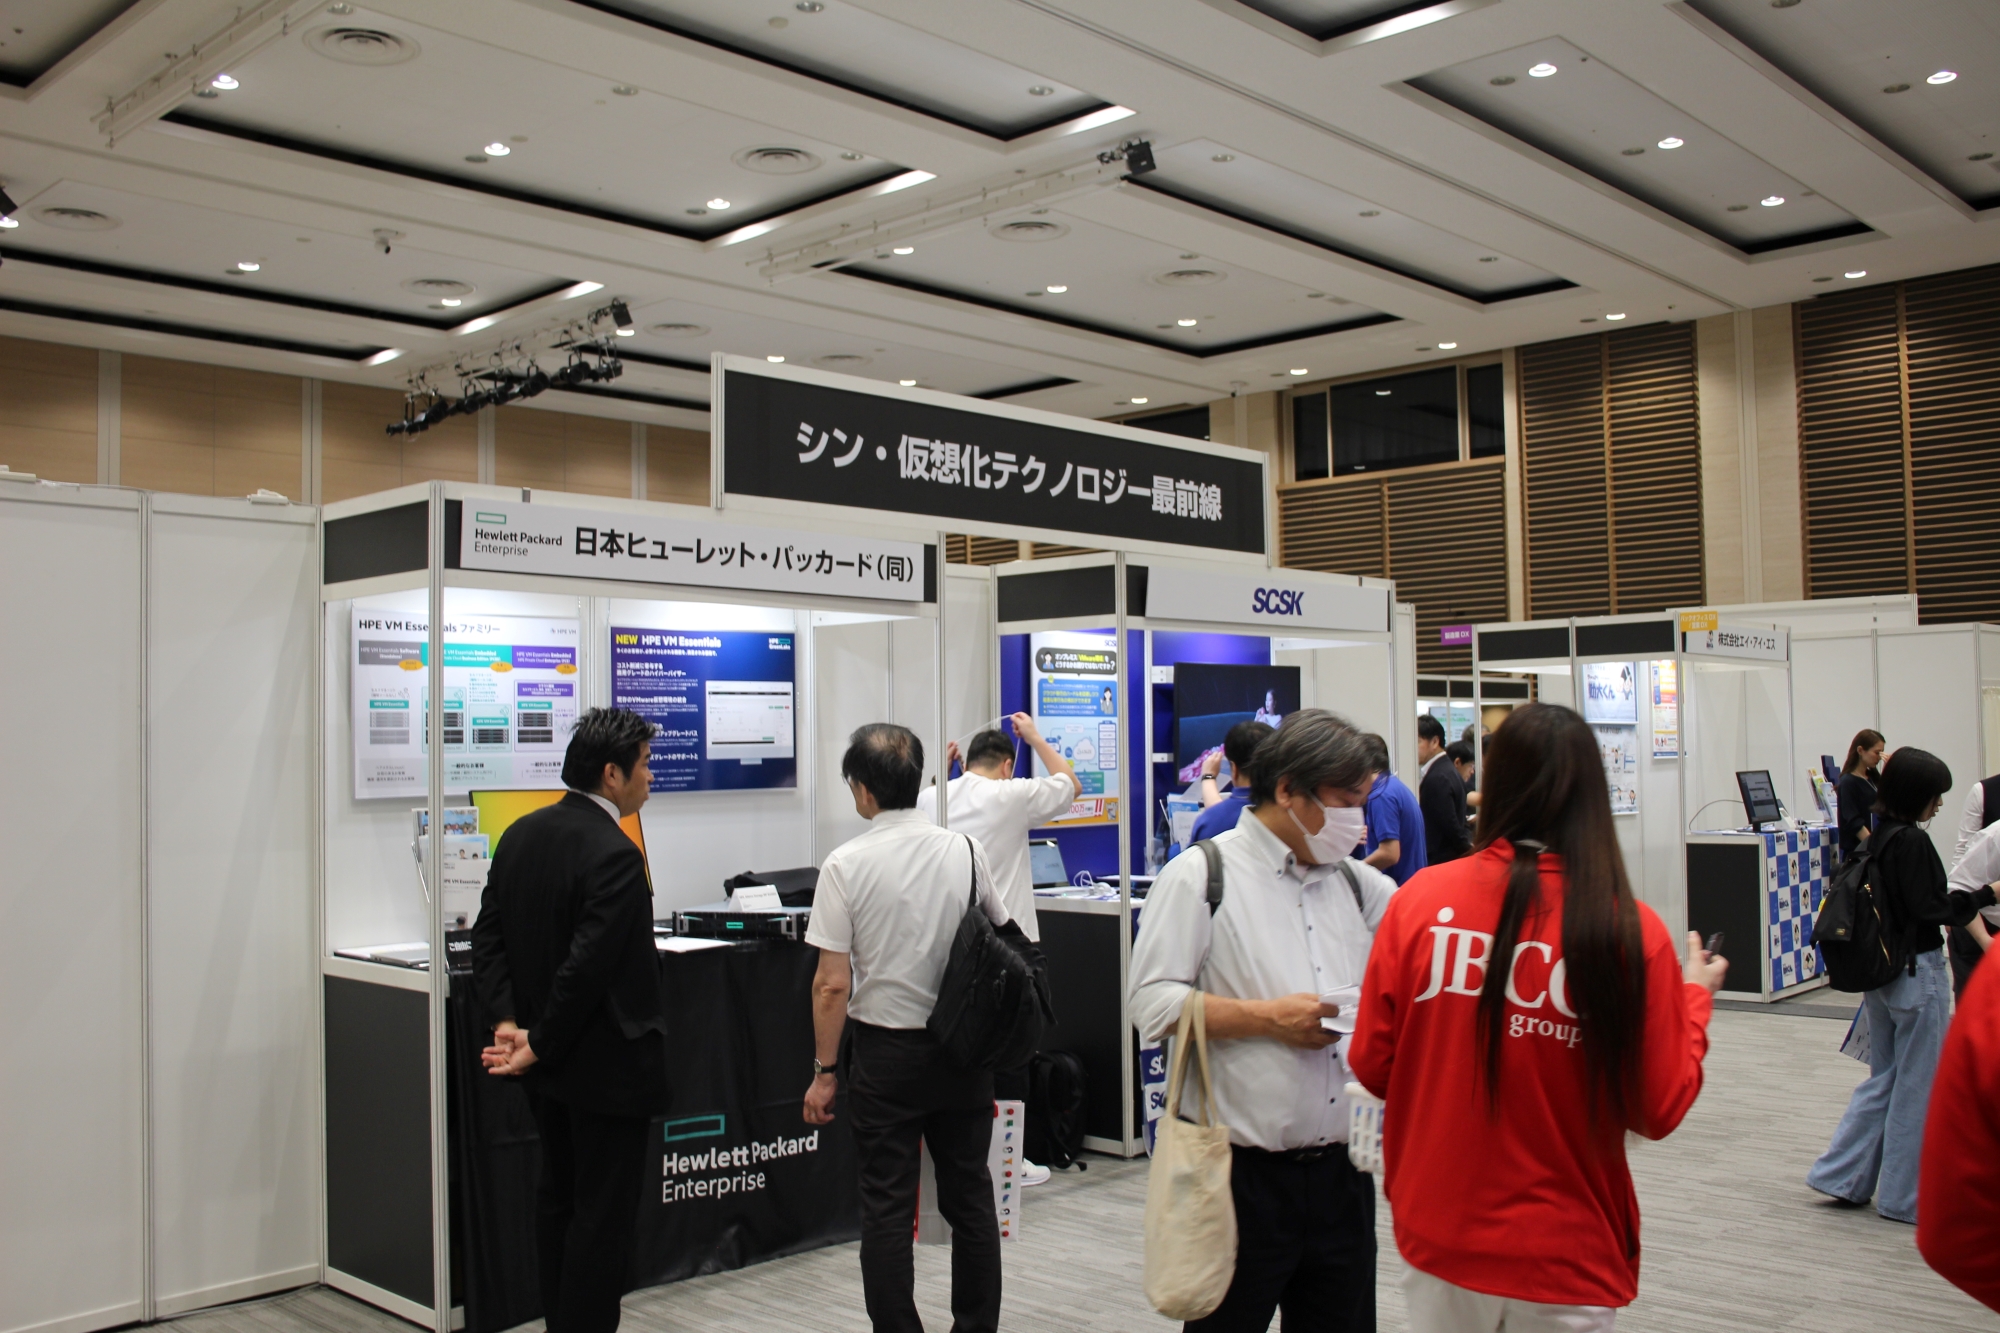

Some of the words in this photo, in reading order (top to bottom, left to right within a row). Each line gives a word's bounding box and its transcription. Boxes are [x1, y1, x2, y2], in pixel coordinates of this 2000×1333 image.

[796, 421, 1222, 521] シン・仮想化テクノロジー最前線
[475, 528, 518, 543] Hewlett
[520, 532, 563, 546] Packard
[474, 541, 529, 557] Enterprise
[1252, 587, 1304, 616] SCSK
[359, 619, 382, 630] HPE
[385, 620, 403, 631] VM
[405, 621, 457, 632] Esseals
[460, 623, 501, 634] ファミリー
[1460, 630, 1470, 638] DX
[615, 634, 638, 645] NEW
[641, 635, 661, 646] HPE
[662, 635, 678, 646] VM
[678, 636, 722, 648] Essentials
[1718, 632, 1776, 650] 株式会社エイ・アイ・エス
[1509, 1013, 1583, 1048] group
[663, 1146, 750, 1176] Hewlett
[751, 1129, 819, 1164] Packard
[662, 1171, 766, 1204] Enterprise
